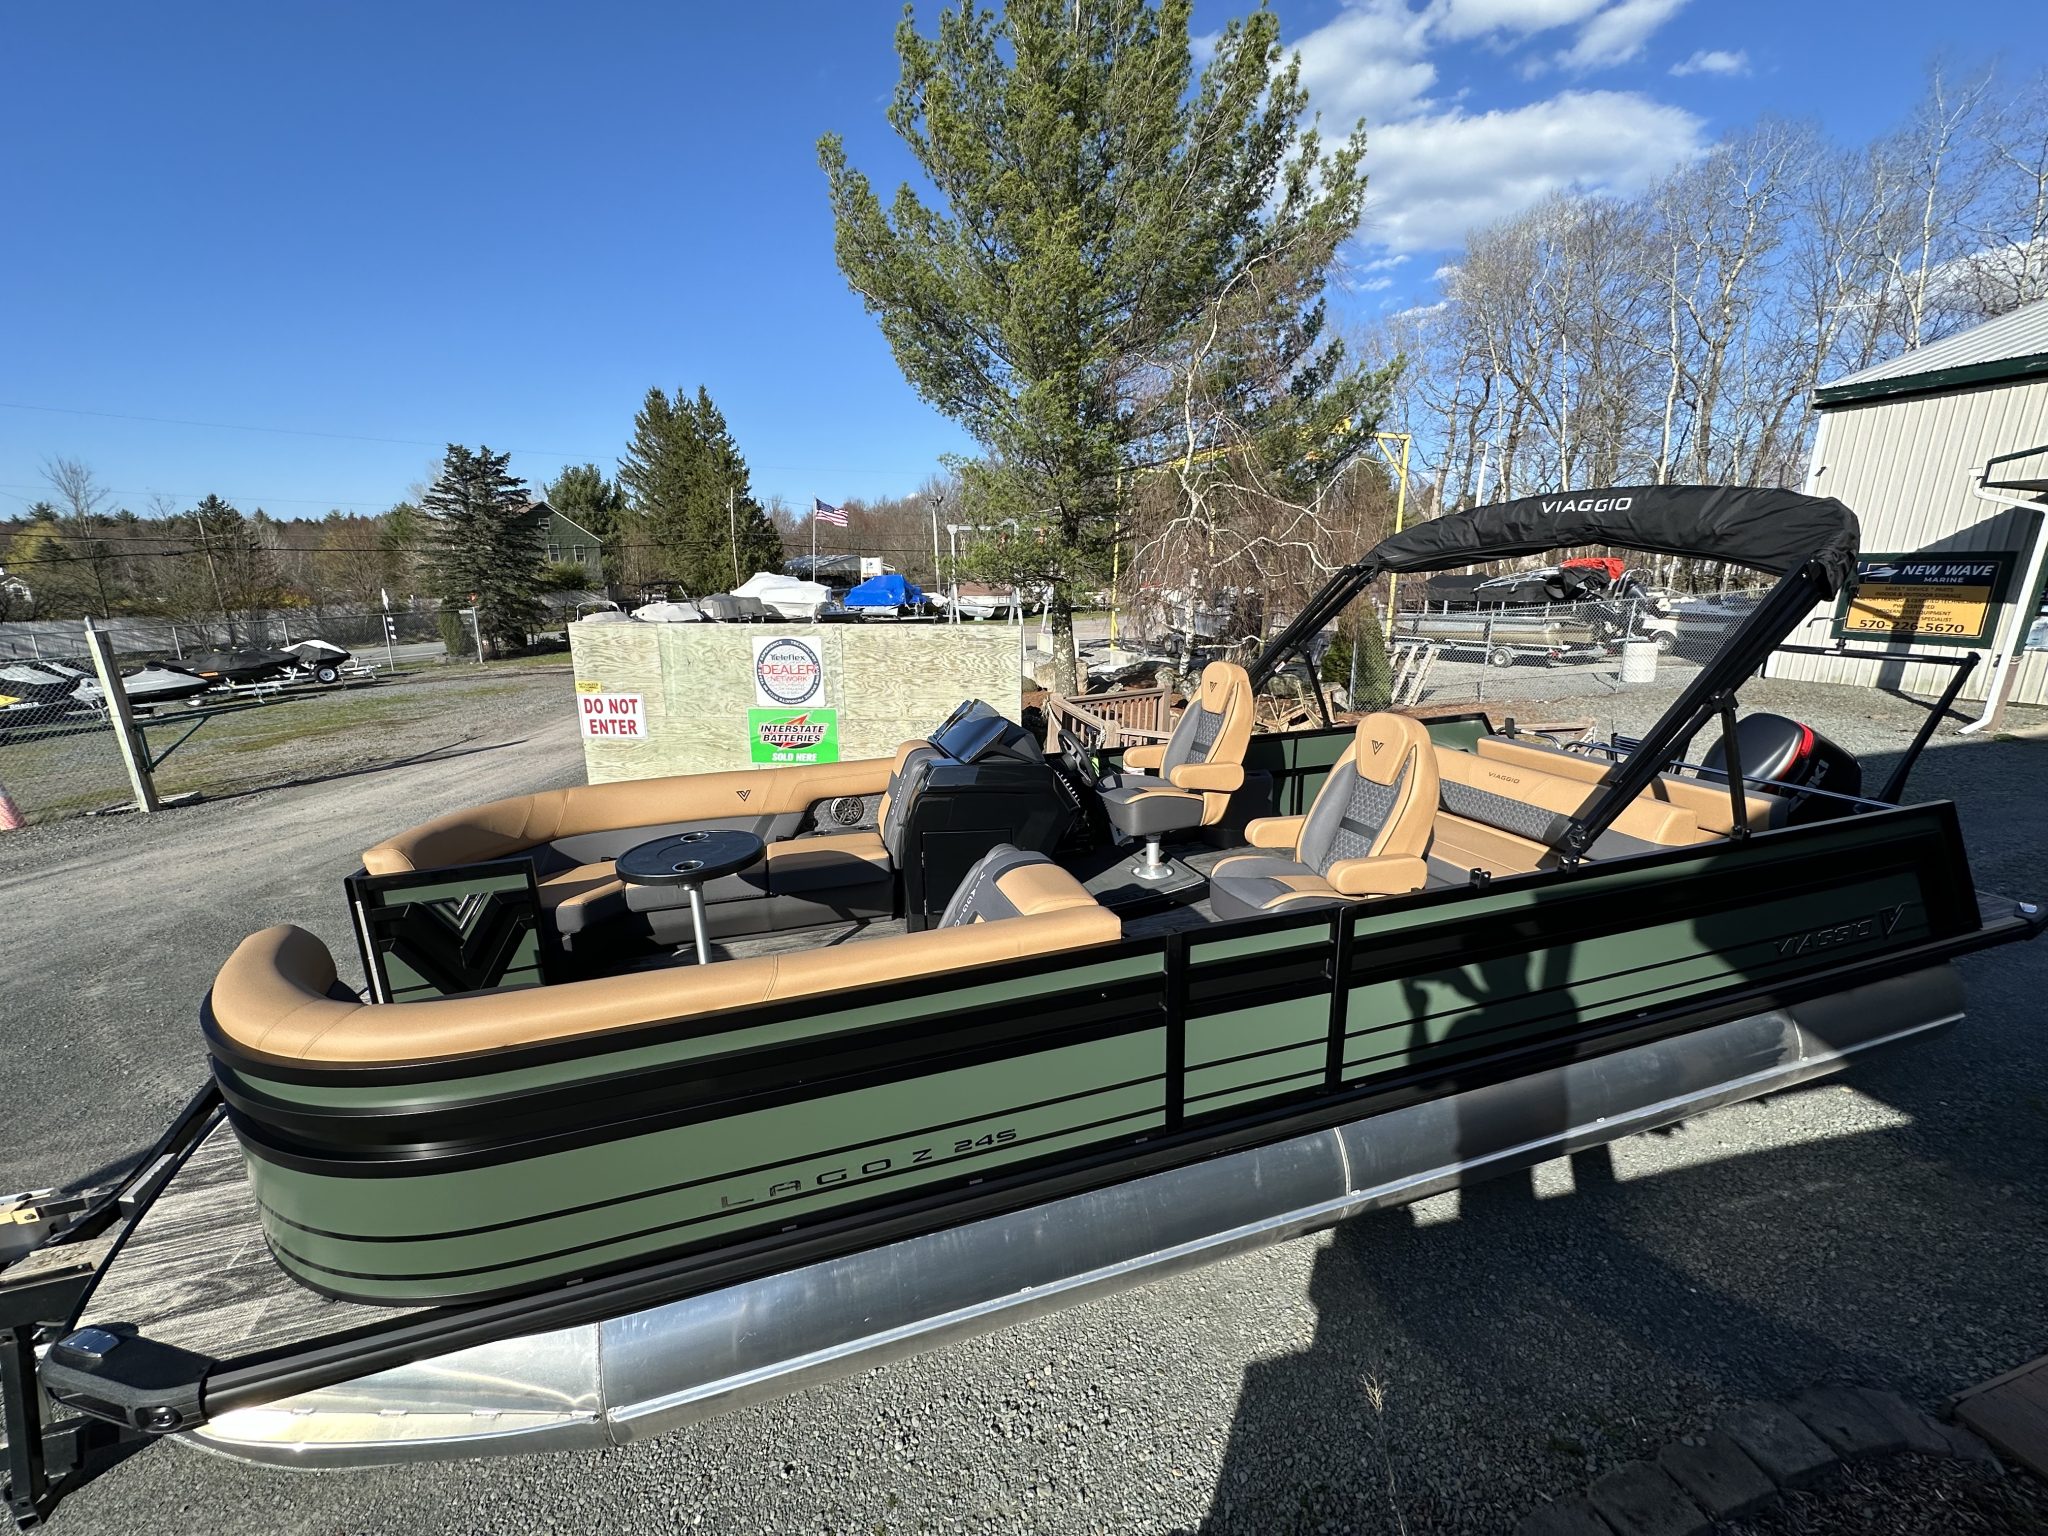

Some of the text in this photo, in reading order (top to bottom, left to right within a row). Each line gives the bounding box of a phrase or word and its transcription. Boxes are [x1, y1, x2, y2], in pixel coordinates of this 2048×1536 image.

[1541, 497, 1633, 514] VIAGGIO
[1901, 565, 1995, 576] NEW WAVE
[1859, 620, 1965, 634] 570-226-5670
[770, 653, 806, 661] Teleflex
[761, 664, 817, 675] DEALER
[583, 698, 638, 714] DO NOT
[589, 718, 638, 735] ENTER
[760, 725, 825, 733] INTERSTATE
[763, 734, 821, 742] BATTERIES
[772, 752, 817, 762] SOLD HERE
[1488, 771, 1521, 784] VIAGGIO
[1773, 919, 1873, 955] VIAGGIO
[721, 1128, 1017, 1209] LAGO Z 24S
